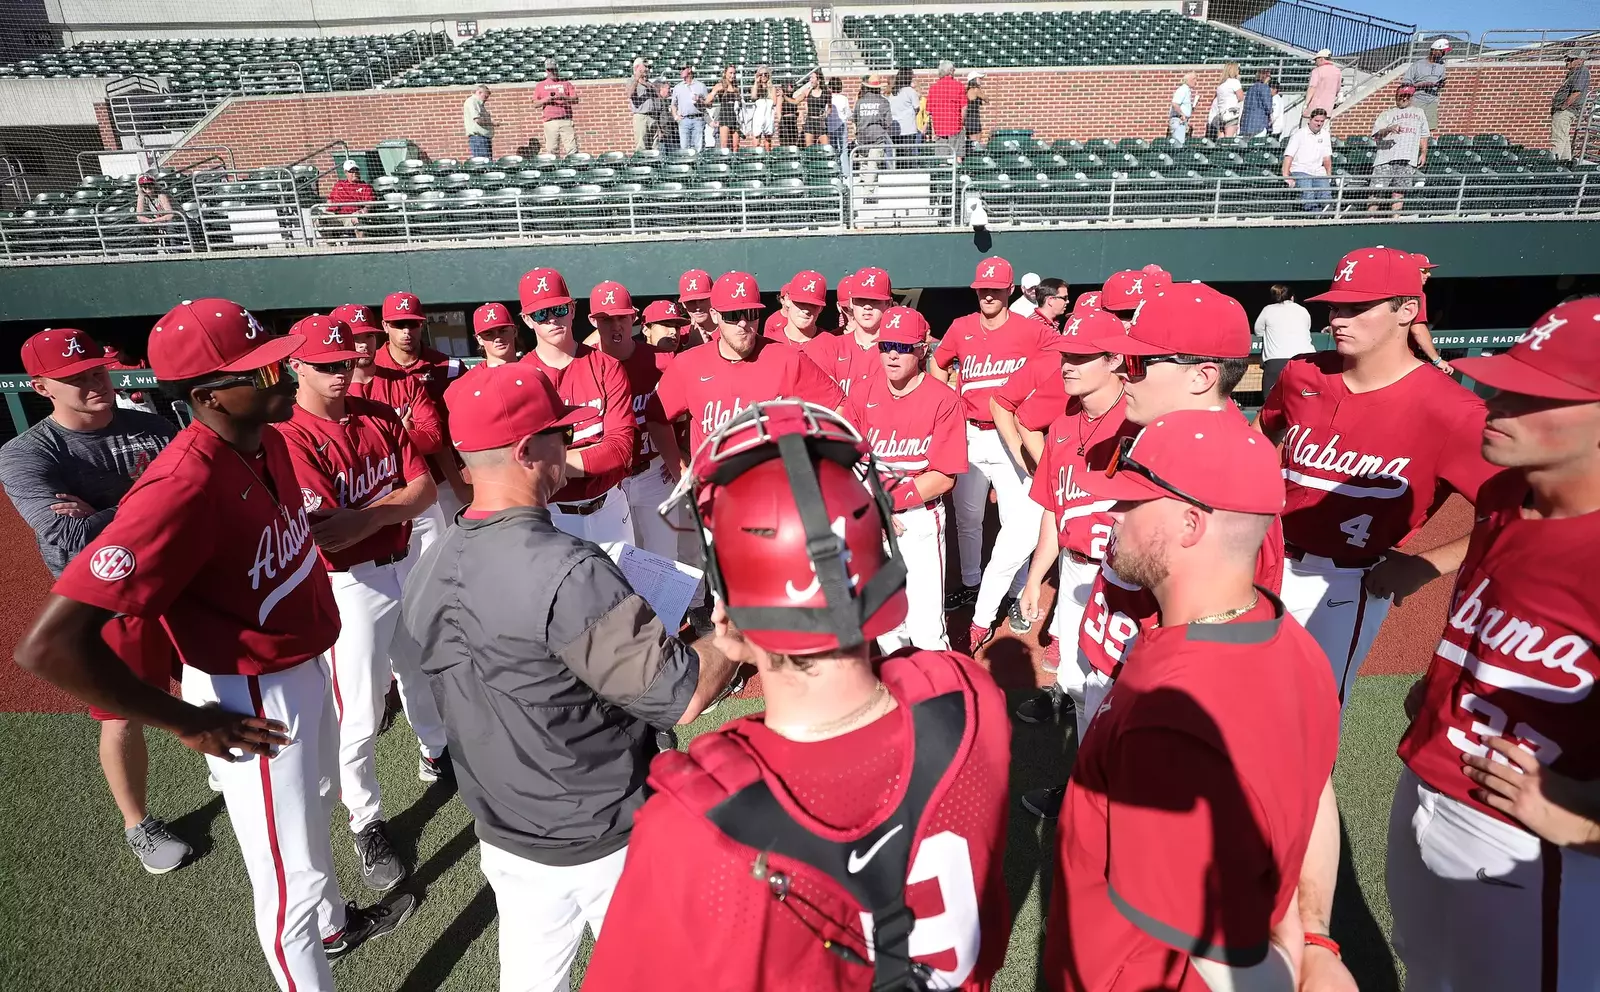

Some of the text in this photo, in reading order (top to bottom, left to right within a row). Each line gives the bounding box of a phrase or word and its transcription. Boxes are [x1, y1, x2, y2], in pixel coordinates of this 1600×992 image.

[982, 266, 996, 279] A
[1334, 260, 1359, 283] A
[534, 276, 551, 294] A
[686, 278, 701, 292] A
[803, 279, 818, 293] A
[861, 275, 877, 288] A
[1125, 279, 1144, 295] A
[601, 291, 616, 305] A
[730, 282, 748, 298] A
[395, 298, 411, 311] A
[1081, 295, 1098, 306] A
[350, 309, 367, 323] A
[484, 308, 498, 322] A
[665, 303, 679, 315] A
[886, 313, 901, 328] A
[1063, 318, 1083, 336] A
[323, 326, 344, 345] A
[1432, 336, 1465, 344] GENDS
[1492, 335, 1520, 343] MADE
[1517, 313, 1569, 351] A
[62, 337, 85, 357] A
[962, 354, 1027, 381] Alabama
[120, 375, 132, 387] A
[1285, 424, 1412, 480] Alabama
[334, 452, 398, 509] Alabam
[1340, 513, 1374, 548] 4
[248, 505, 312, 590] Alaba
[93, 547, 132, 579] SEC
[1084, 591, 1139, 662] 39
[1450, 578, 1593, 674] bama
